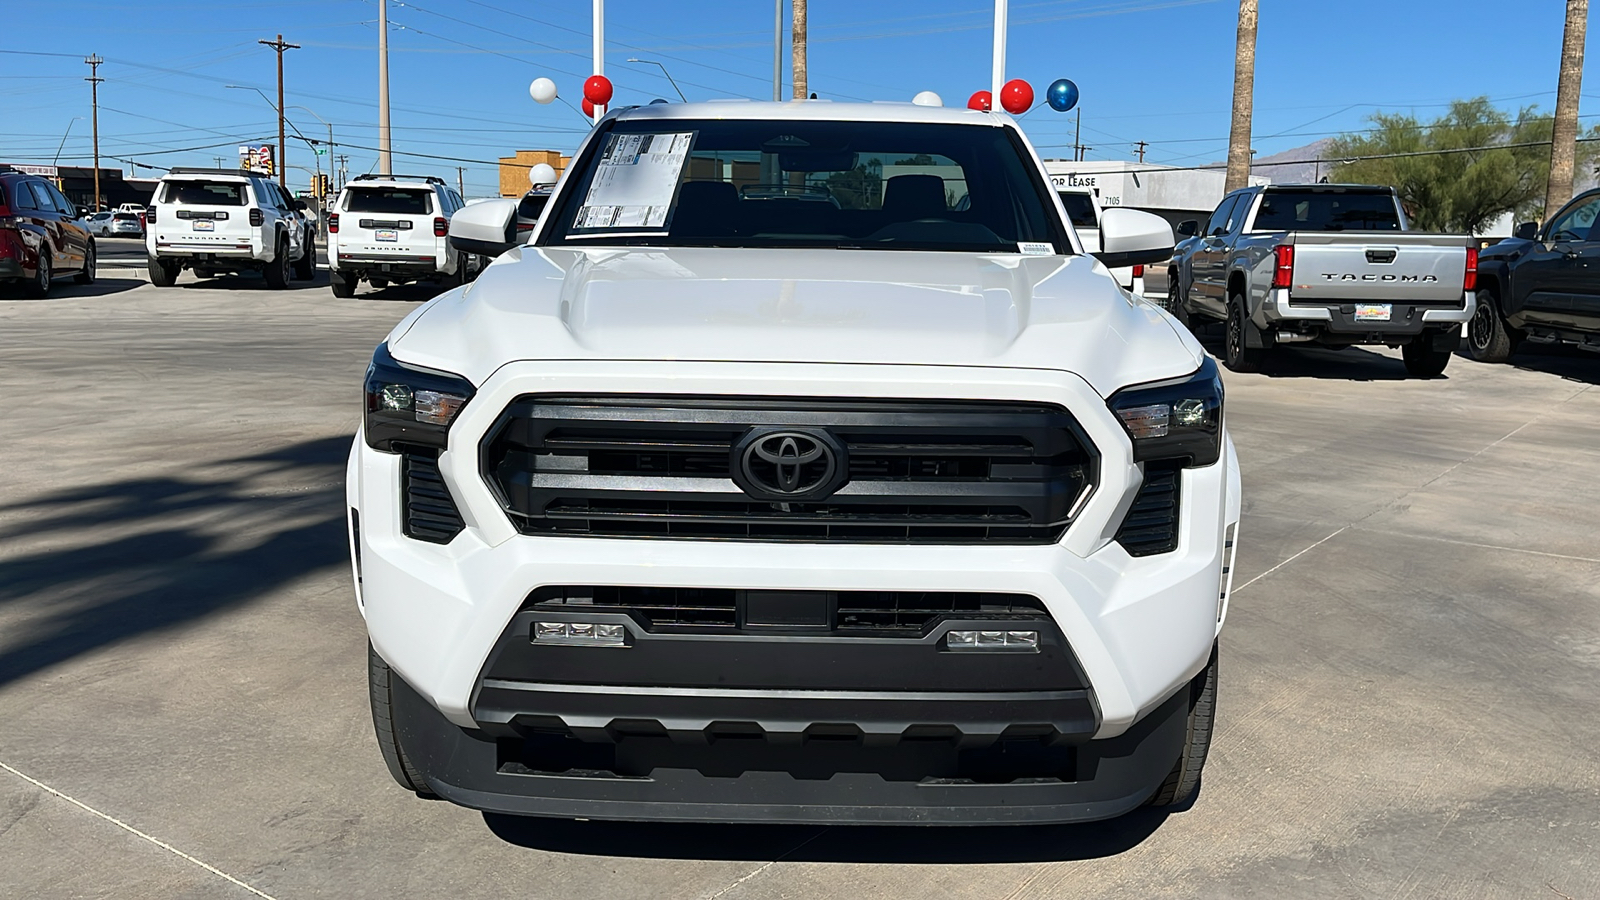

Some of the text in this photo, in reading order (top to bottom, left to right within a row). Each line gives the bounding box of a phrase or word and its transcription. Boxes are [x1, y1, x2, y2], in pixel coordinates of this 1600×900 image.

[1051, 178, 1096, 187] OR LEASE
[1104, 196, 1120, 205] 7105
[1321, 273, 1439, 284] TACOMA
